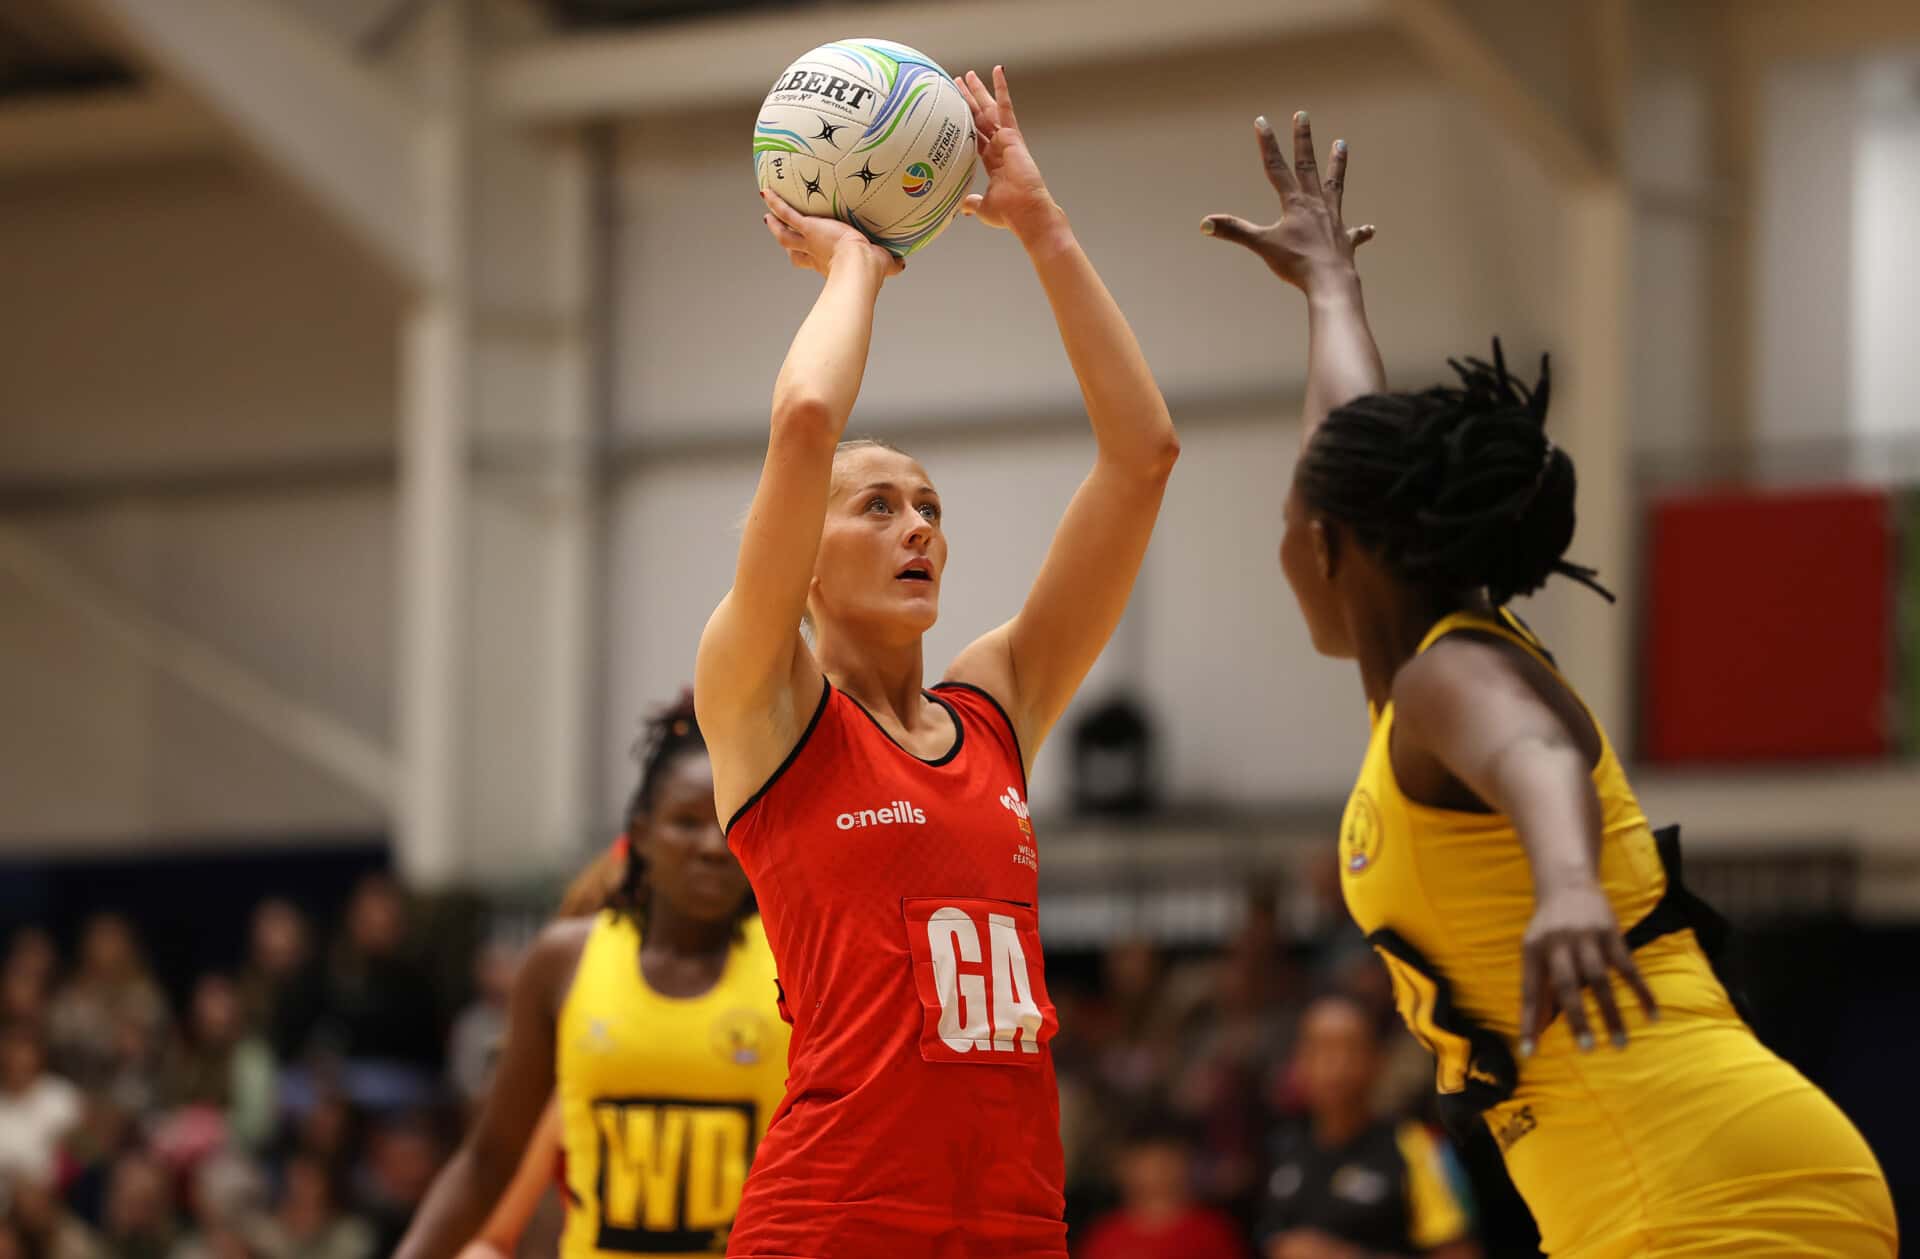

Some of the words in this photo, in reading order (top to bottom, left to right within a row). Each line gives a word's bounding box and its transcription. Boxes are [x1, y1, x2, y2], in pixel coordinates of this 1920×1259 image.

[931, 122, 956, 166] NETBALL
[927, 906, 1043, 1054] GA
[598, 1103, 749, 1232] WD
